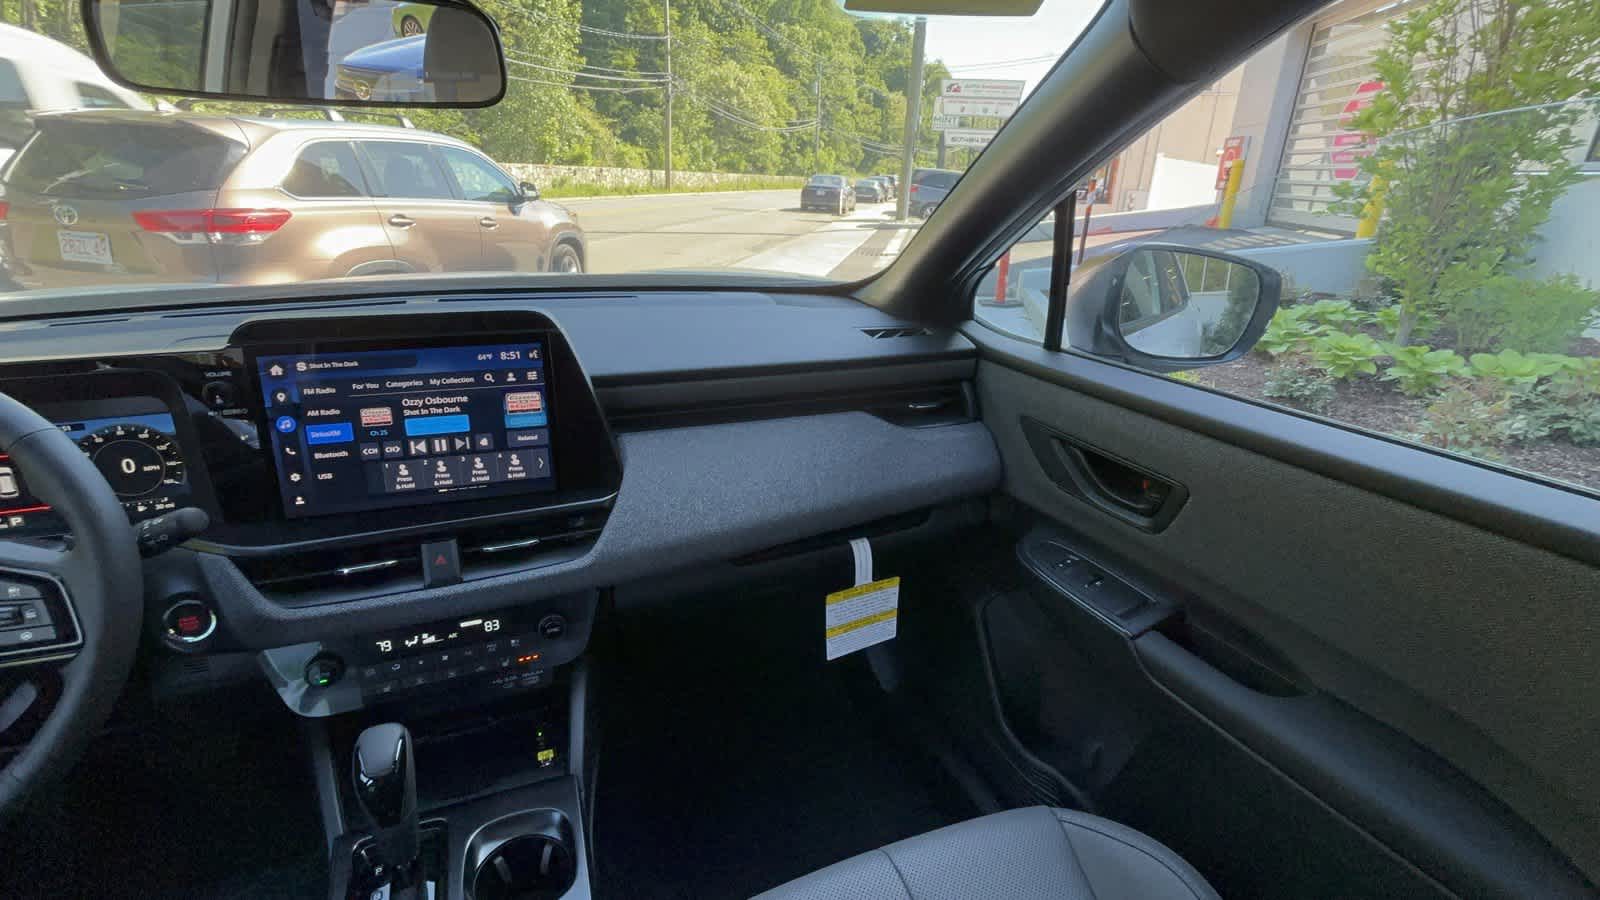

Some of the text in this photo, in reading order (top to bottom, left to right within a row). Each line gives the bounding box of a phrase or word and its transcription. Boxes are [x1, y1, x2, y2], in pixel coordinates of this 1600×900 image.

[500, 351, 521, 361] 8:51
[386, 379, 424, 388] Categories
[441, 376, 475, 384] Collection
[402, 394, 469, 408] Ozzy Osbourne
[320, 408, 341, 416] Radio
[403, 408, 420, 416] Shot
[444, 405, 461, 413] Dark
[314, 450, 349, 460] Bluetooth
[121, 458, 136, 474] 0
[317, 472, 333, 480] USB
[484, 619, 500, 632] 83
[376, 640, 392, 652] 79
